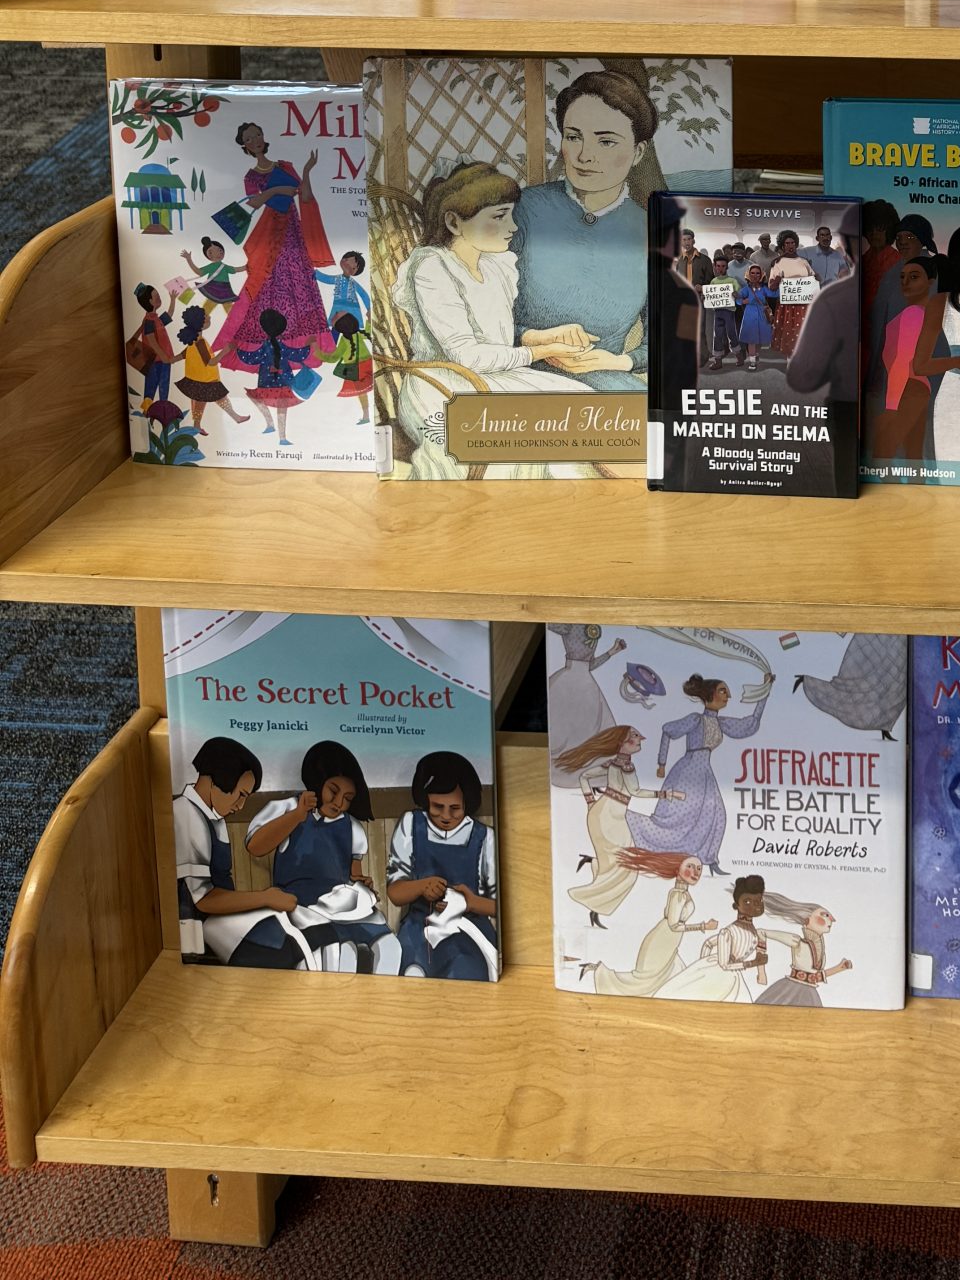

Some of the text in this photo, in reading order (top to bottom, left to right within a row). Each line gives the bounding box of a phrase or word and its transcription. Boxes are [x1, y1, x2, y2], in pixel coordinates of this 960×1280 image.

[850, 143, 940, 167] BRAVE.
[893, 176, 914, 188] 50+
[919, 177, 958, 189] African
[909, 193, 934, 204] Who
[704, 208, 800, 219] GIRLS SURVIVE
[682, 389, 828, 419] ESSIE AND THE
[461, 407, 640, 432] Annie and Helen
[673, 421, 830, 442] MARCH ON SELMA
[468, 440, 511, 448] DEBORAH
[514, 440, 568, 448] HOPKINSON
[582, 439, 603, 447] RAUL
[250, 450, 302, 460] Reem Faruqi
[714, 448, 800, 462] Bloody Sunday
[709, 460, 793, 474] Survival Story
[891, 467, 955, 478] Willis Hudson
[693, 629, 716, 641] FOR
[196, 676, 455, 709] The Secret Pocket
[230, 718, 308, 732] Peggy Janicki
[340, 724, 426, 735] Carrielynn Victor
[734, 748, 880, 787] SUFFRAGETTE
[734, 787, 881, 815] THE BATTLE
[737, 814, 882, 835] FOR EQUALITY
[752, 838, 868, 858] David Roberts
